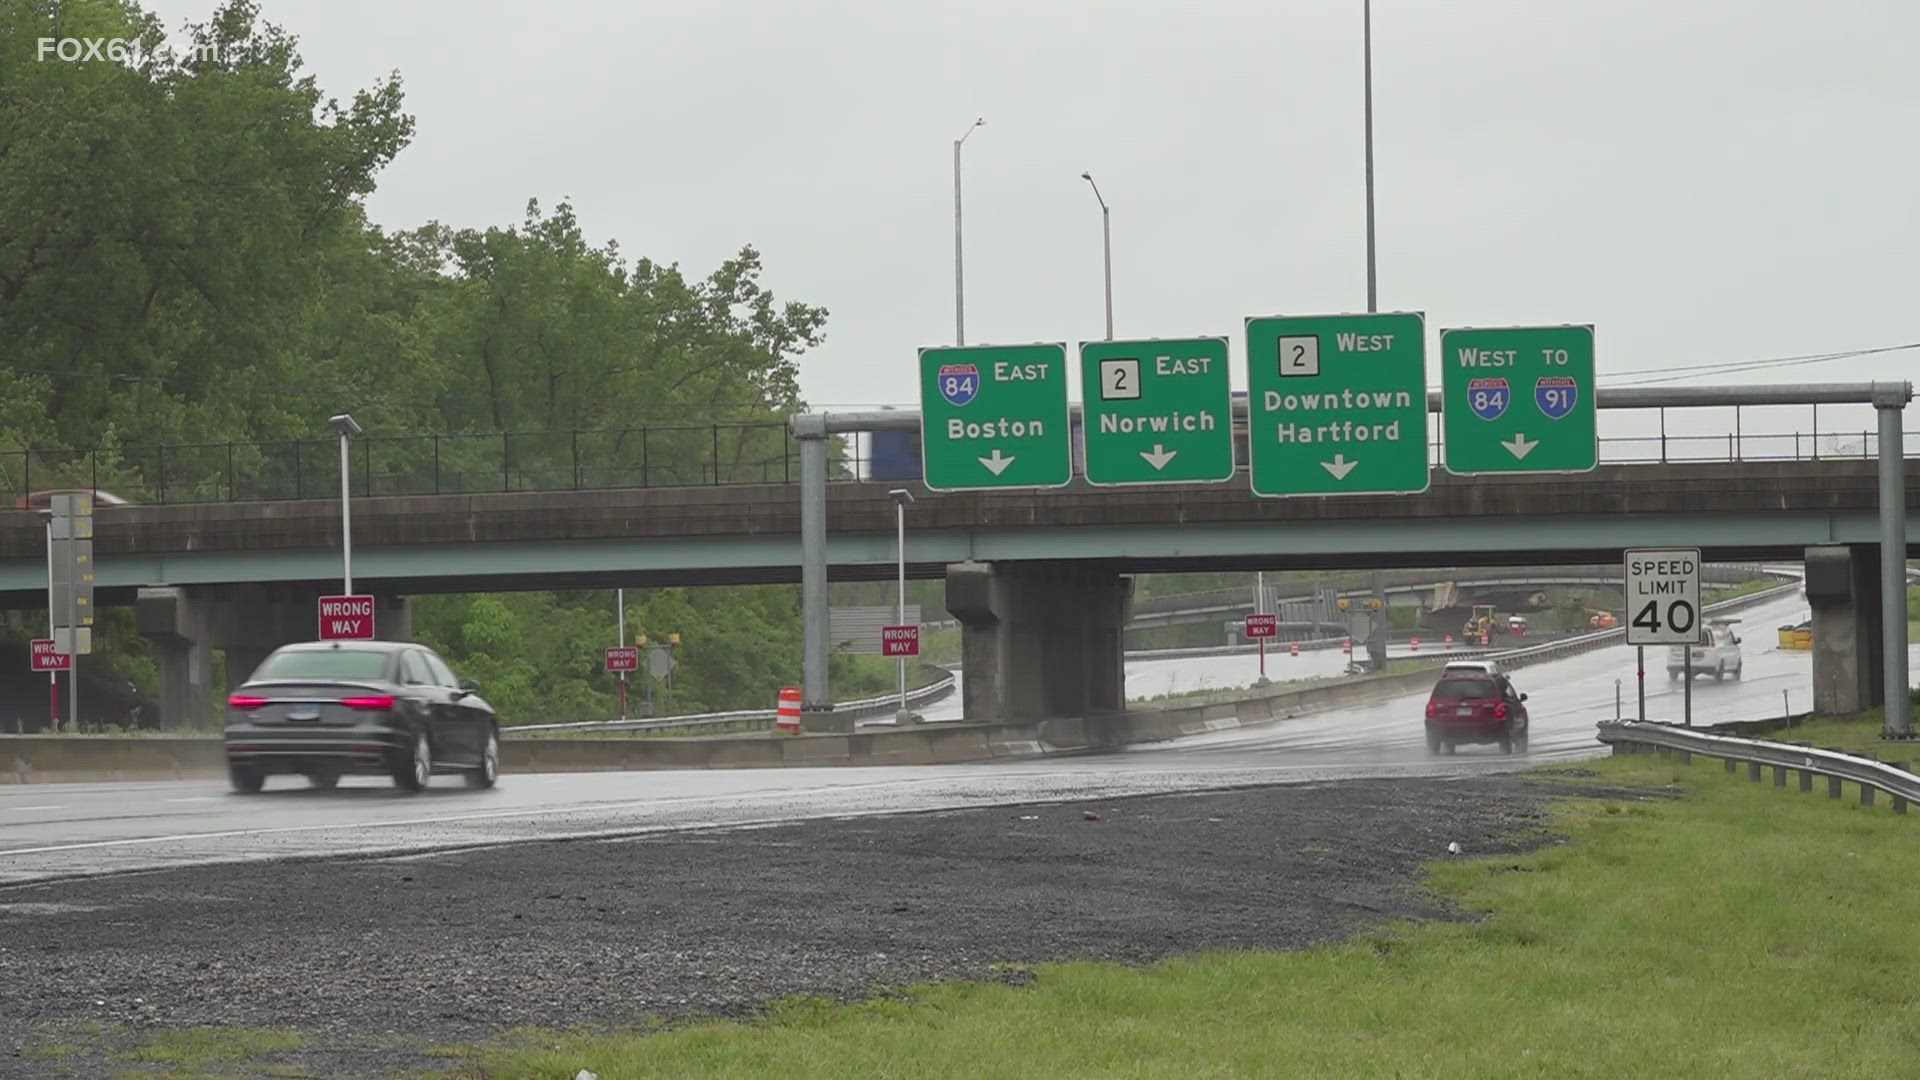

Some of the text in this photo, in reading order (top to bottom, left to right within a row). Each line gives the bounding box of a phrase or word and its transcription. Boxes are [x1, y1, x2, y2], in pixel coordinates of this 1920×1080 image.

[1336, 332, 1394, 353] WEST
[1156, 355, 1211, 376] EAST
[1292, 345, 1306, 367] 2
[1458, 347, 1569, 368] WEST TO
[994, 362, 1049, 381] EAST
[1114, 368, 1127, 391] 2
[946, 377, 973, 397] 84
[1264, 388, 1411, 413] Downtown
[1475, 391, 1503, 411] 84
[1545, 389, 1568, 409] 91
[948, 416, 1044, 440] Boston
[1100, 410, 1215, 434] Norwich
[1278, 420, 1400, 444] Hartford
[1631, 560, 1694, 577] SPEED
[1639, 580, 1687, 596] LIMIT
[322, 601, 371, 616] WRONG
[1632, 599, 1695, 634] 40
[332, 620, 361, 634] WAY
[1247, 616, 1275, 626] WRONG
[1252, 626, 1270, 635] WAY
[884, 629, 917, 640] WRONG
[33, 643, 56, 654] WRO
[607, 650, 636, 659] WRONG
[890, 642, 911, 652] WAY
[41, 656, 64, 666] WAY
[612, 659, 632, 668] WAY
